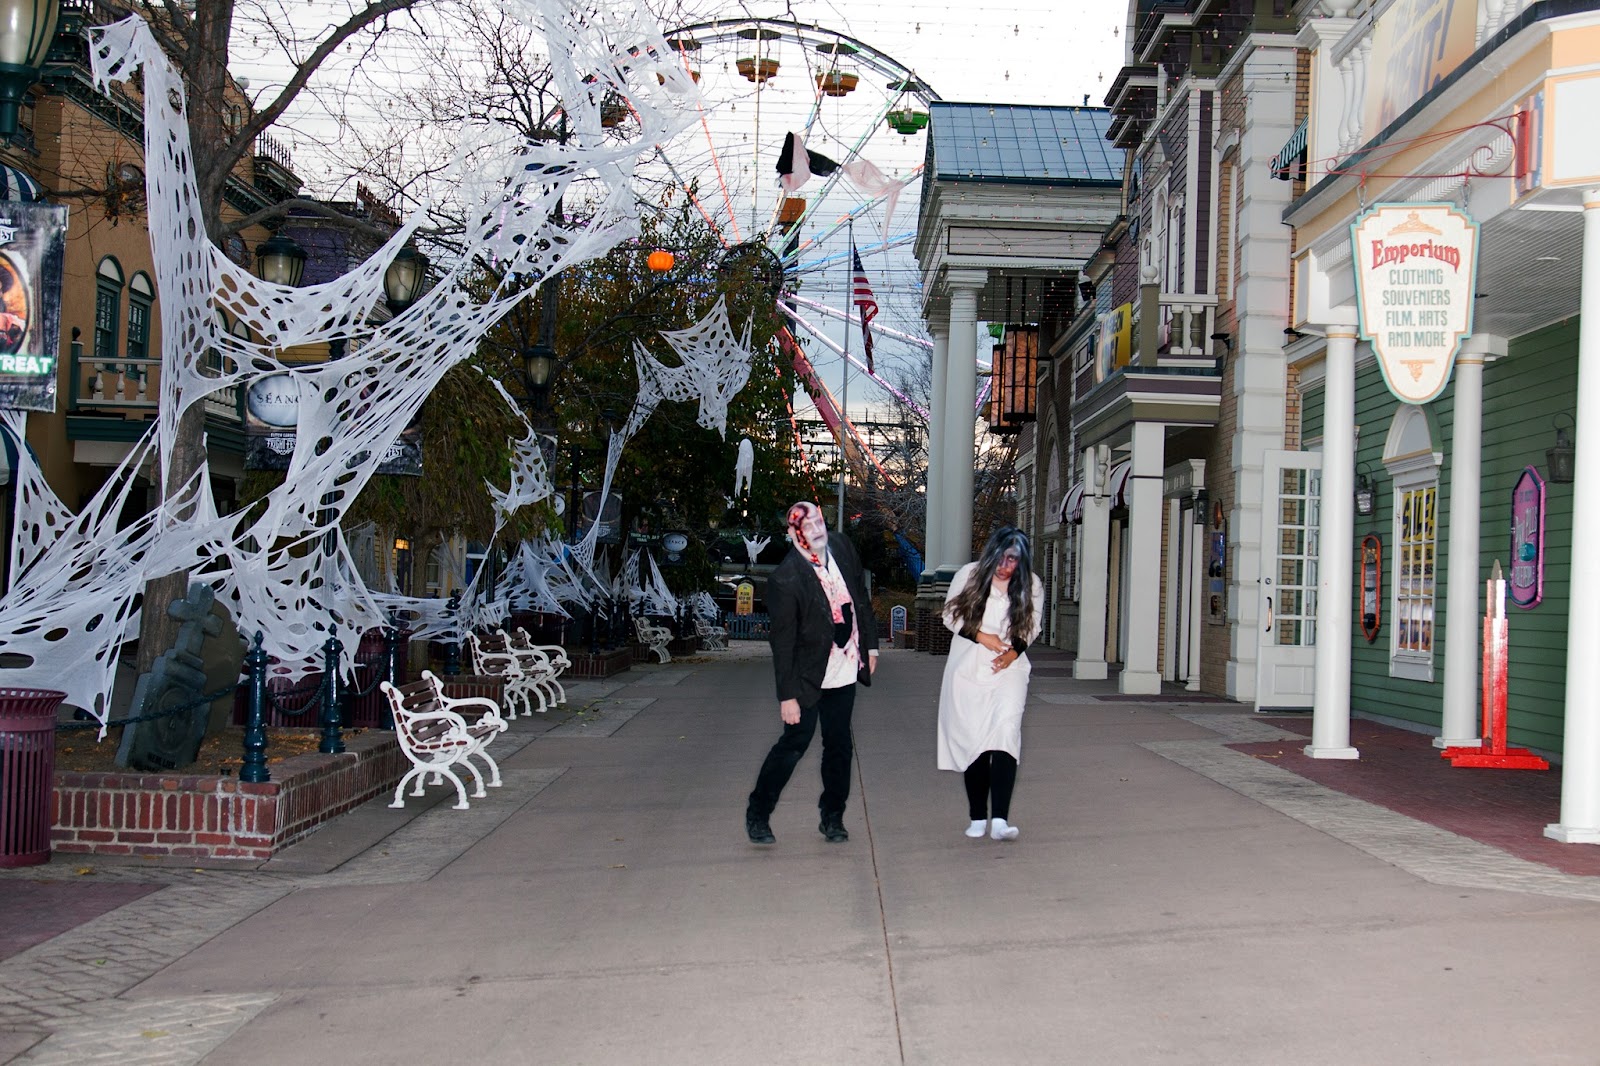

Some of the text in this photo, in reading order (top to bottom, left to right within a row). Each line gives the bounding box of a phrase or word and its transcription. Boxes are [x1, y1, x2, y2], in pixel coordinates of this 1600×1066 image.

[1371, 239, 1461, 274] Emporium
[1389, 268, 1444, 286] CLOTHING
[1382, 289, 1451, 306] SOUVENIERS
[1419, 310, 1448, 326] HATS
[1388, 331, 1447, 347] AND MORE
[0, 355, 52, 374] REAT
[256, 392, 302, 404] SÉANC
